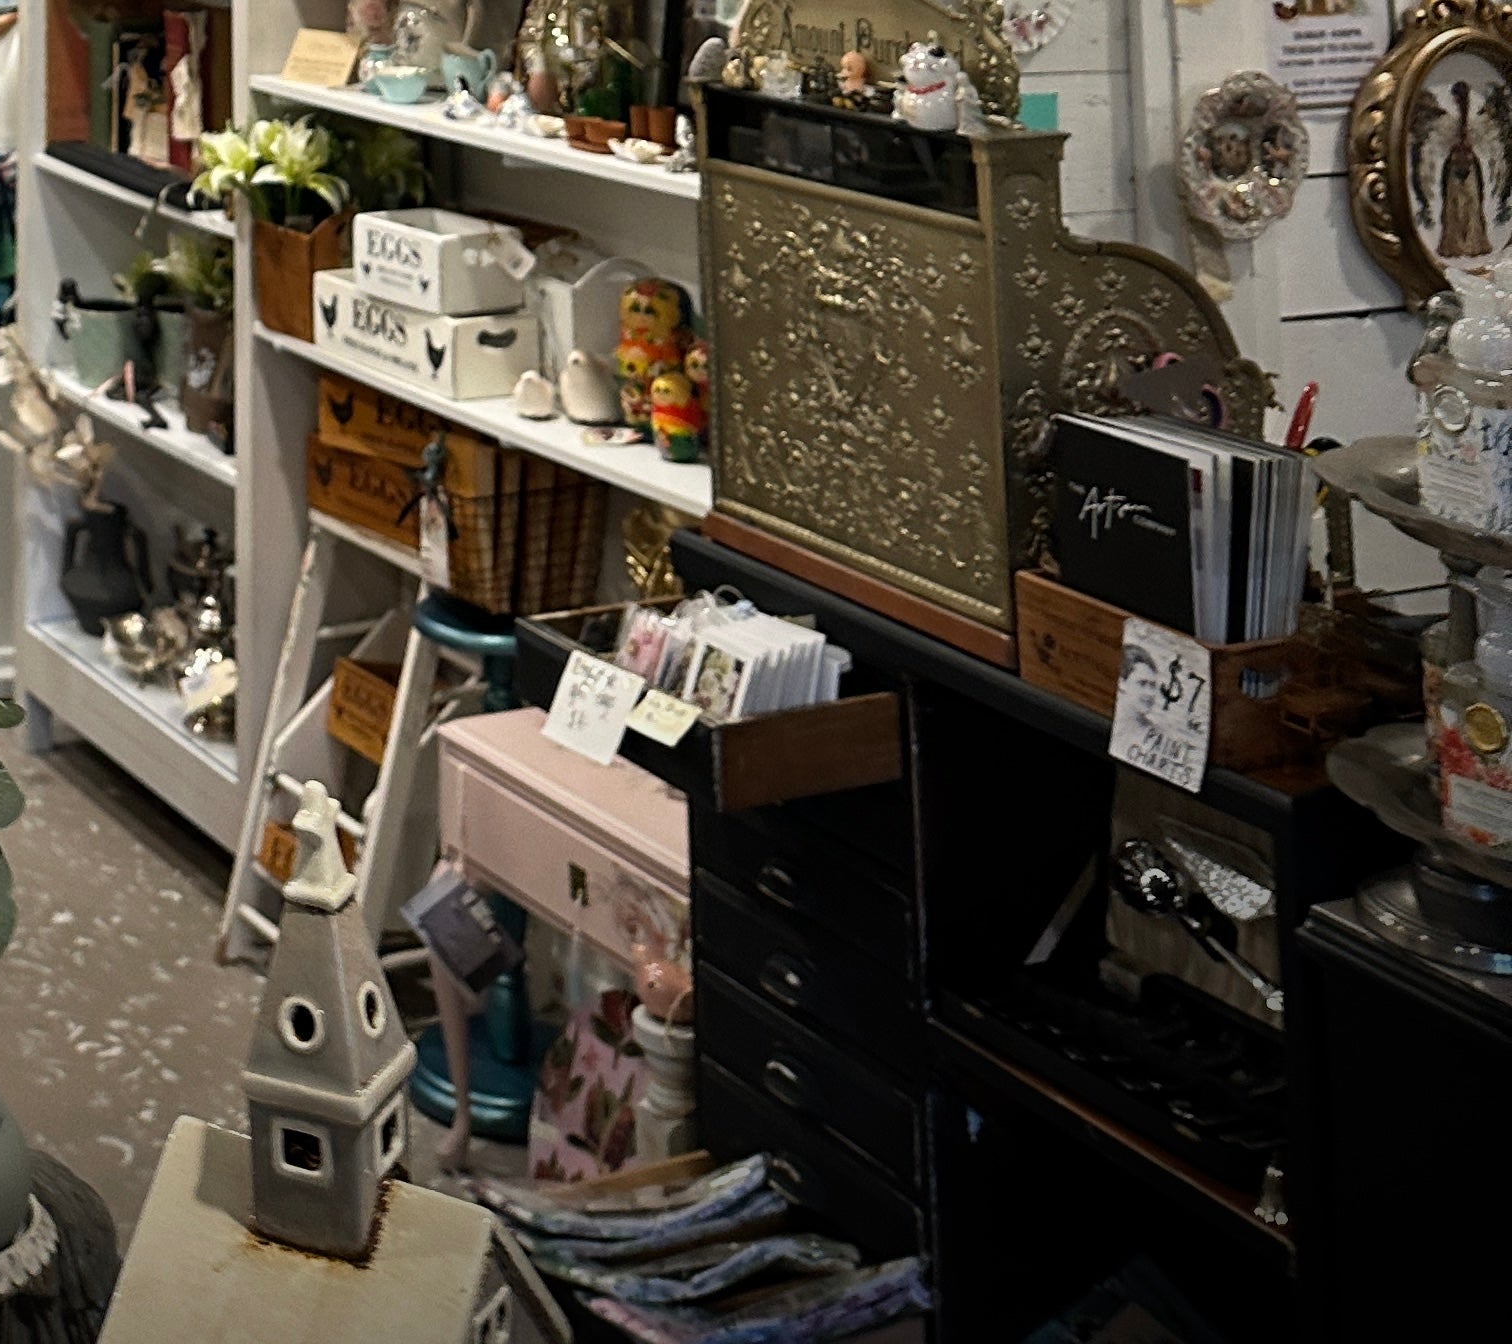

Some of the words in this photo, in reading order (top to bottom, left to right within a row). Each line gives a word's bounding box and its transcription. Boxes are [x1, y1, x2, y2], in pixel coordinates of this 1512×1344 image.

[367, 229, 422, 268] EGGS
[353, 298, 408, 346] EGGS
[1160, 654, 1206, 712] $7
